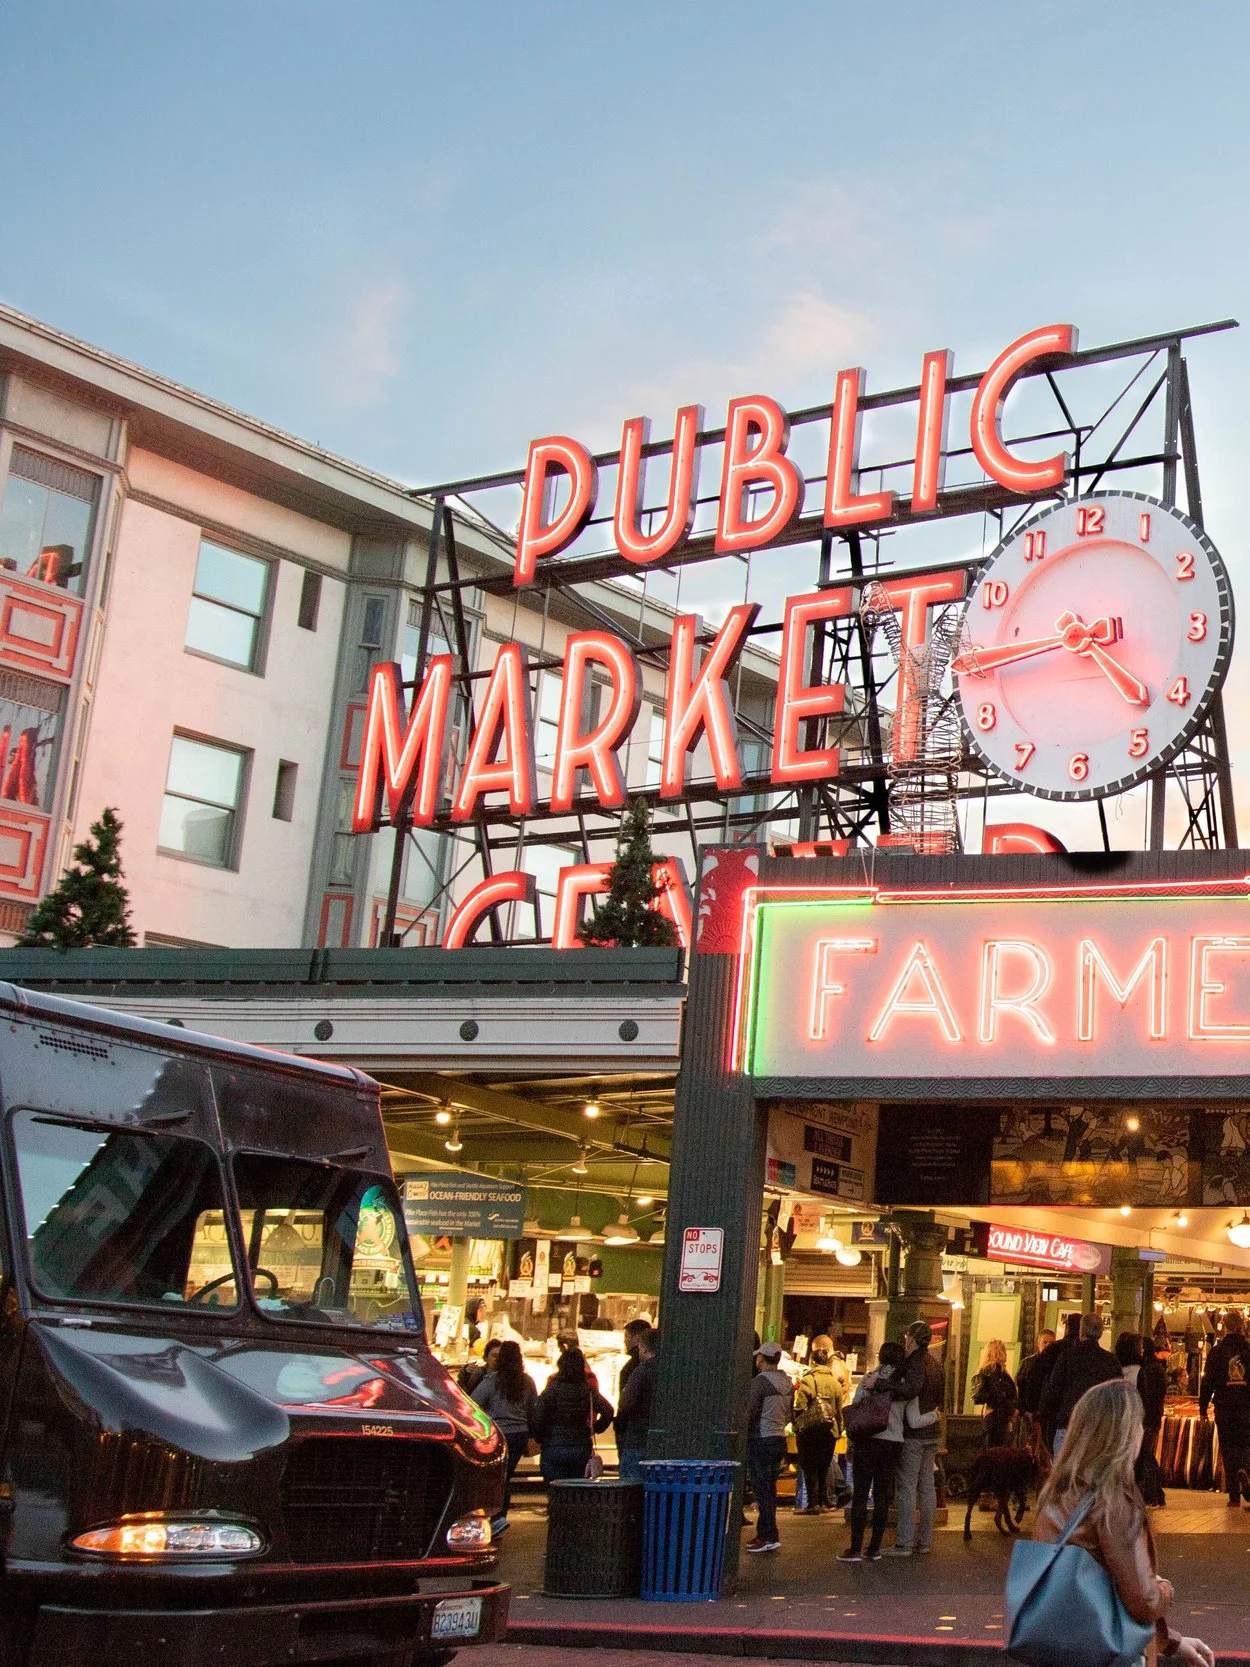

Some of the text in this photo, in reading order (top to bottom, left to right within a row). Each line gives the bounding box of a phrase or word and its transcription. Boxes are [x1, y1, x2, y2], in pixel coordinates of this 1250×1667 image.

[513, 324, 1078, 588] PUBLIC
[1077, 505, 1104, 536] 12
[1140, 512, 1151, 542] 1
[1024, 530, 1046, 562] 11
[1175, 552, 1195, 581] 2
[982, 580, 1009, 609] 10
[1187, 611, 1207, 641] 3
[352, 569, 970, 832] MARKET
[1167, 676, 1191, 706] 4
[977, 702, 996, 731] 8
[1015, 742, 1036, 771] 7
[1128, 727, 1149, 758] 5
[1069, 753, 1089, 782] 6
[429, 1191, 522, 1202] OCEAN-FRIENDLY SEAFOOD
[686, 1230, 698, 1240] NO
[688, 1243, 718, 1254] STOPS
[988, 1226, 1022, 1252] SOUND
[1023, 1232, 1049, 1256] VIEW
[361, 1424, 394, 1437] 154225
